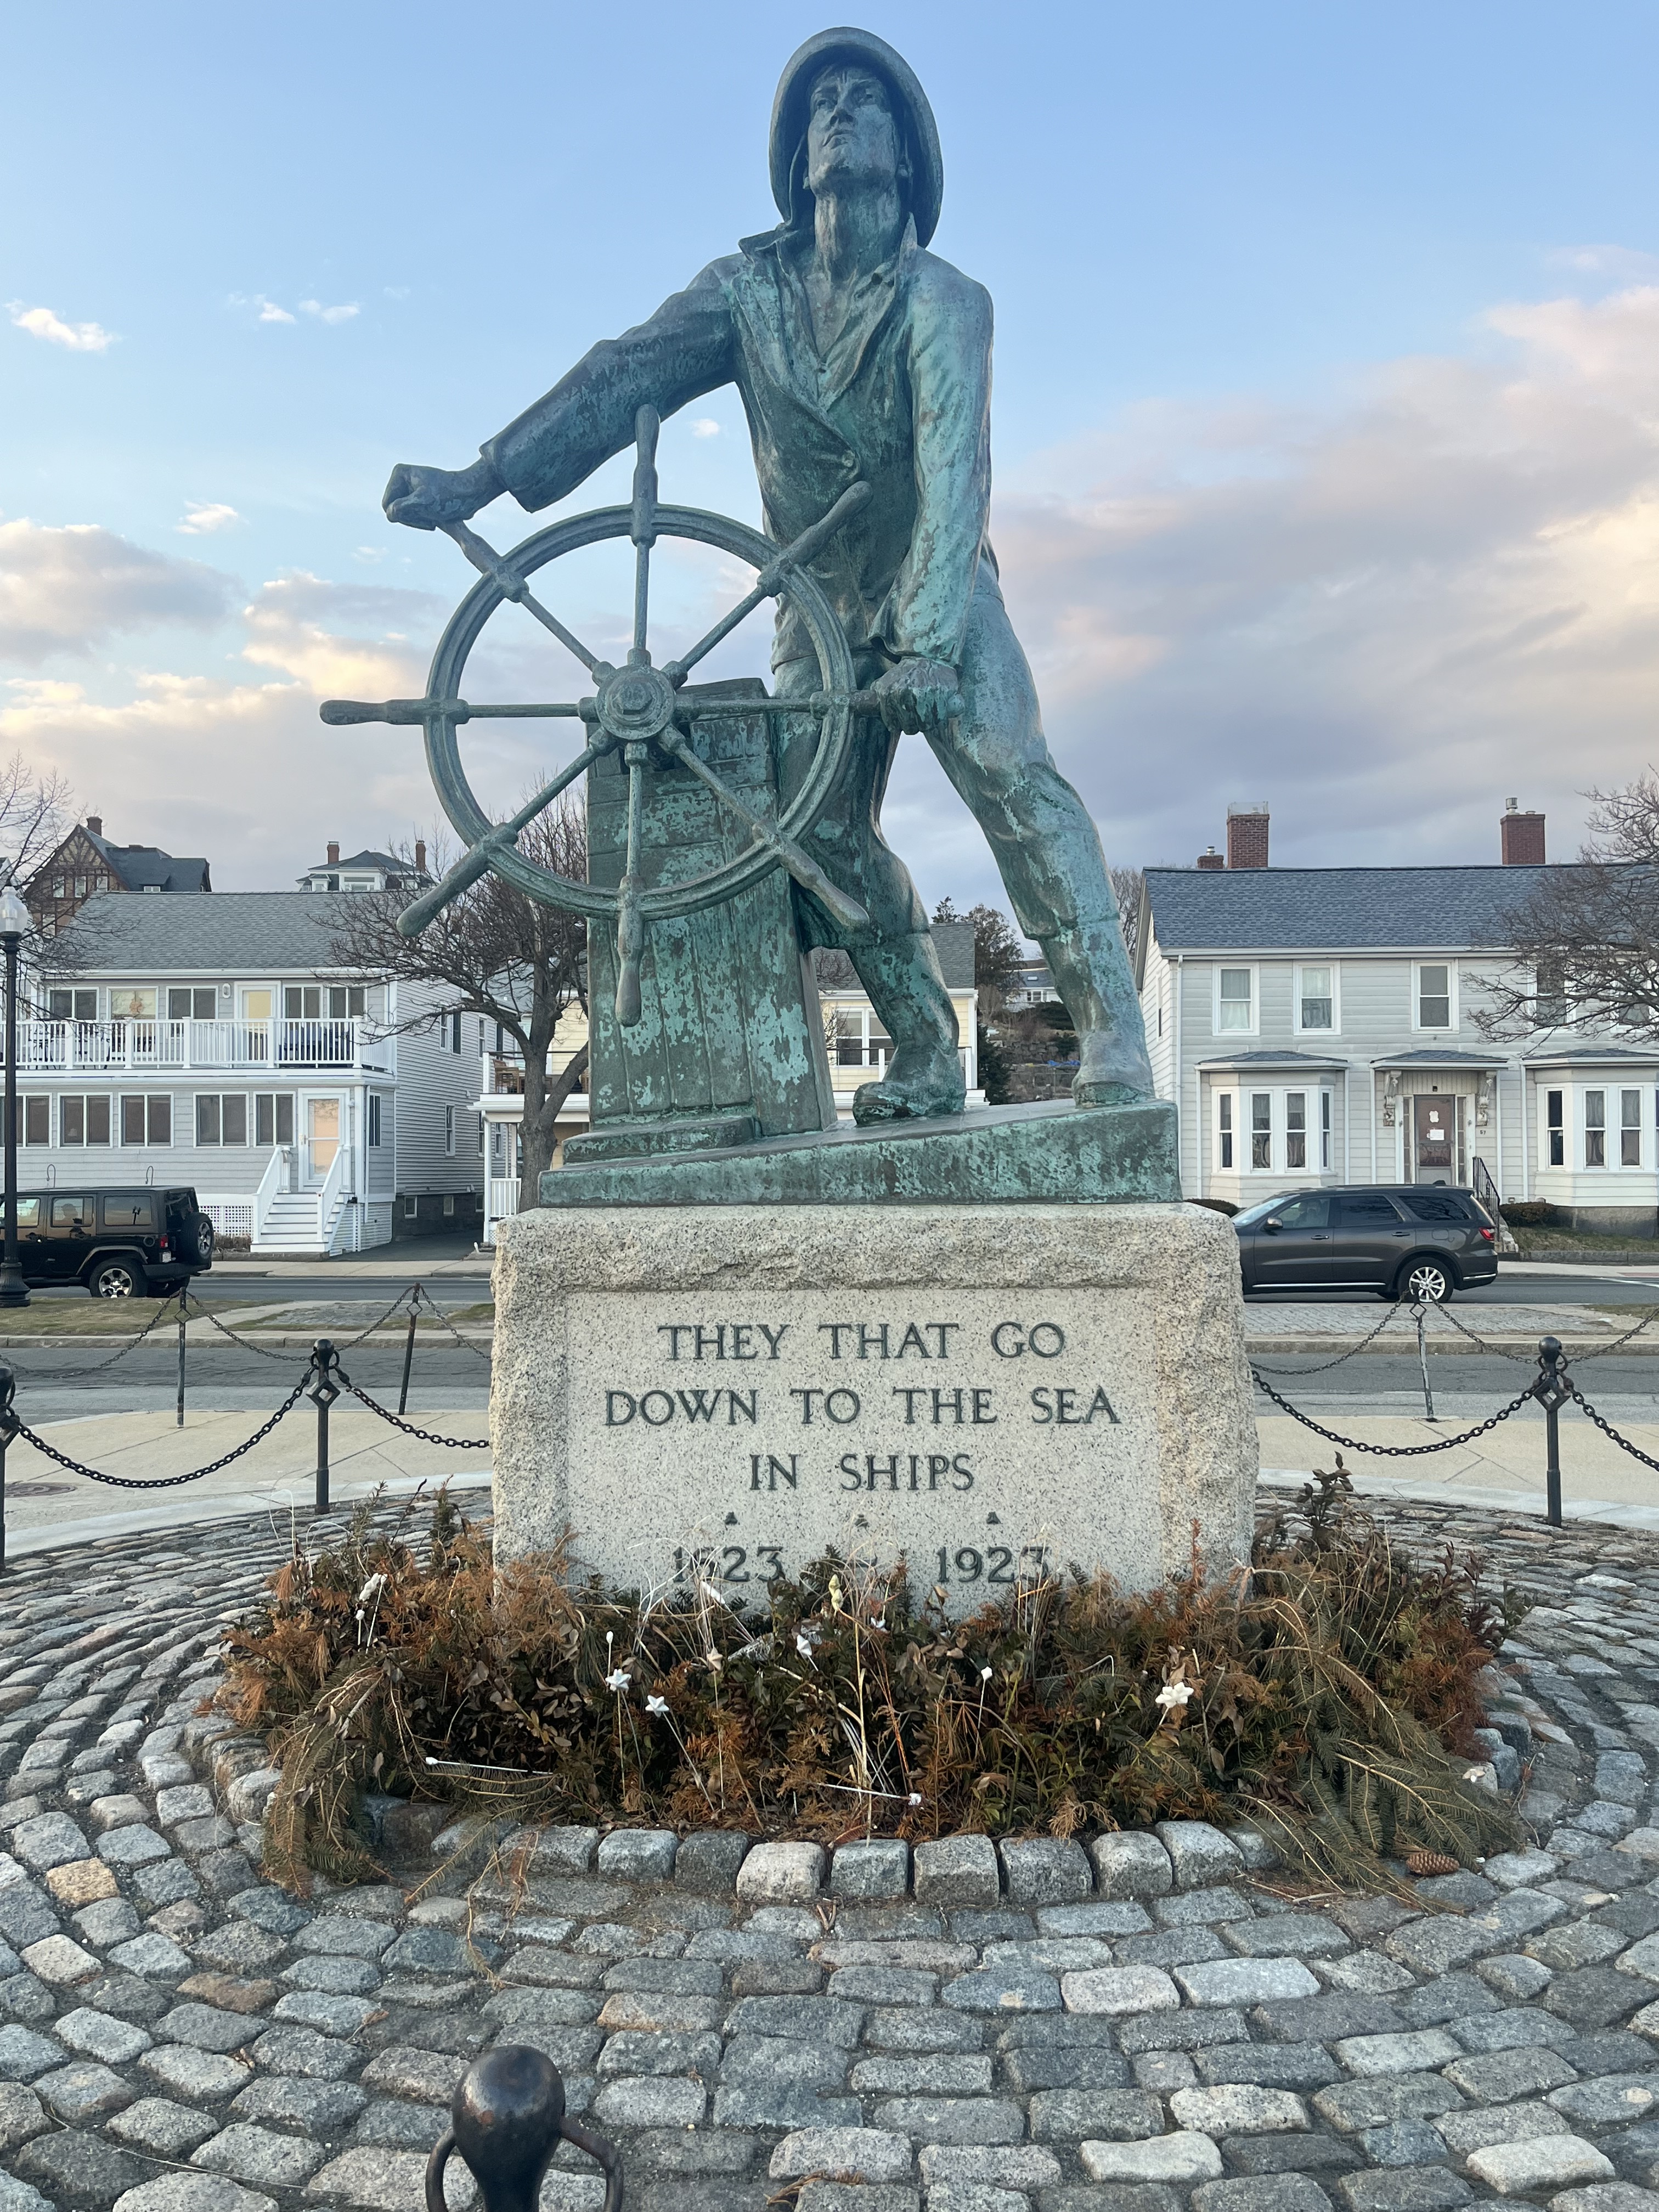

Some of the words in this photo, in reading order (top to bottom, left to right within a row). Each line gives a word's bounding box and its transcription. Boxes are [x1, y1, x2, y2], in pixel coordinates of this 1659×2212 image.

[658, 1324, 788, 1361] THEY
[818, 1323, 960, 1359] THAT
[990, 1321, 1066, 1359] GO
[605, 1389, 757, 1427] DOWN
[789, 1387, 861, 1425] TO
[892, 1387, 997, 1425] THE
[1031, 1386, 1121, 1425] SEA
[749, 1454, 798, 1491] IN
[839, 1452, 975, 1491] SHIPS
[673, 1545, 784, 1583] 1623
[936, 1545, 1050, 1583] 1923
